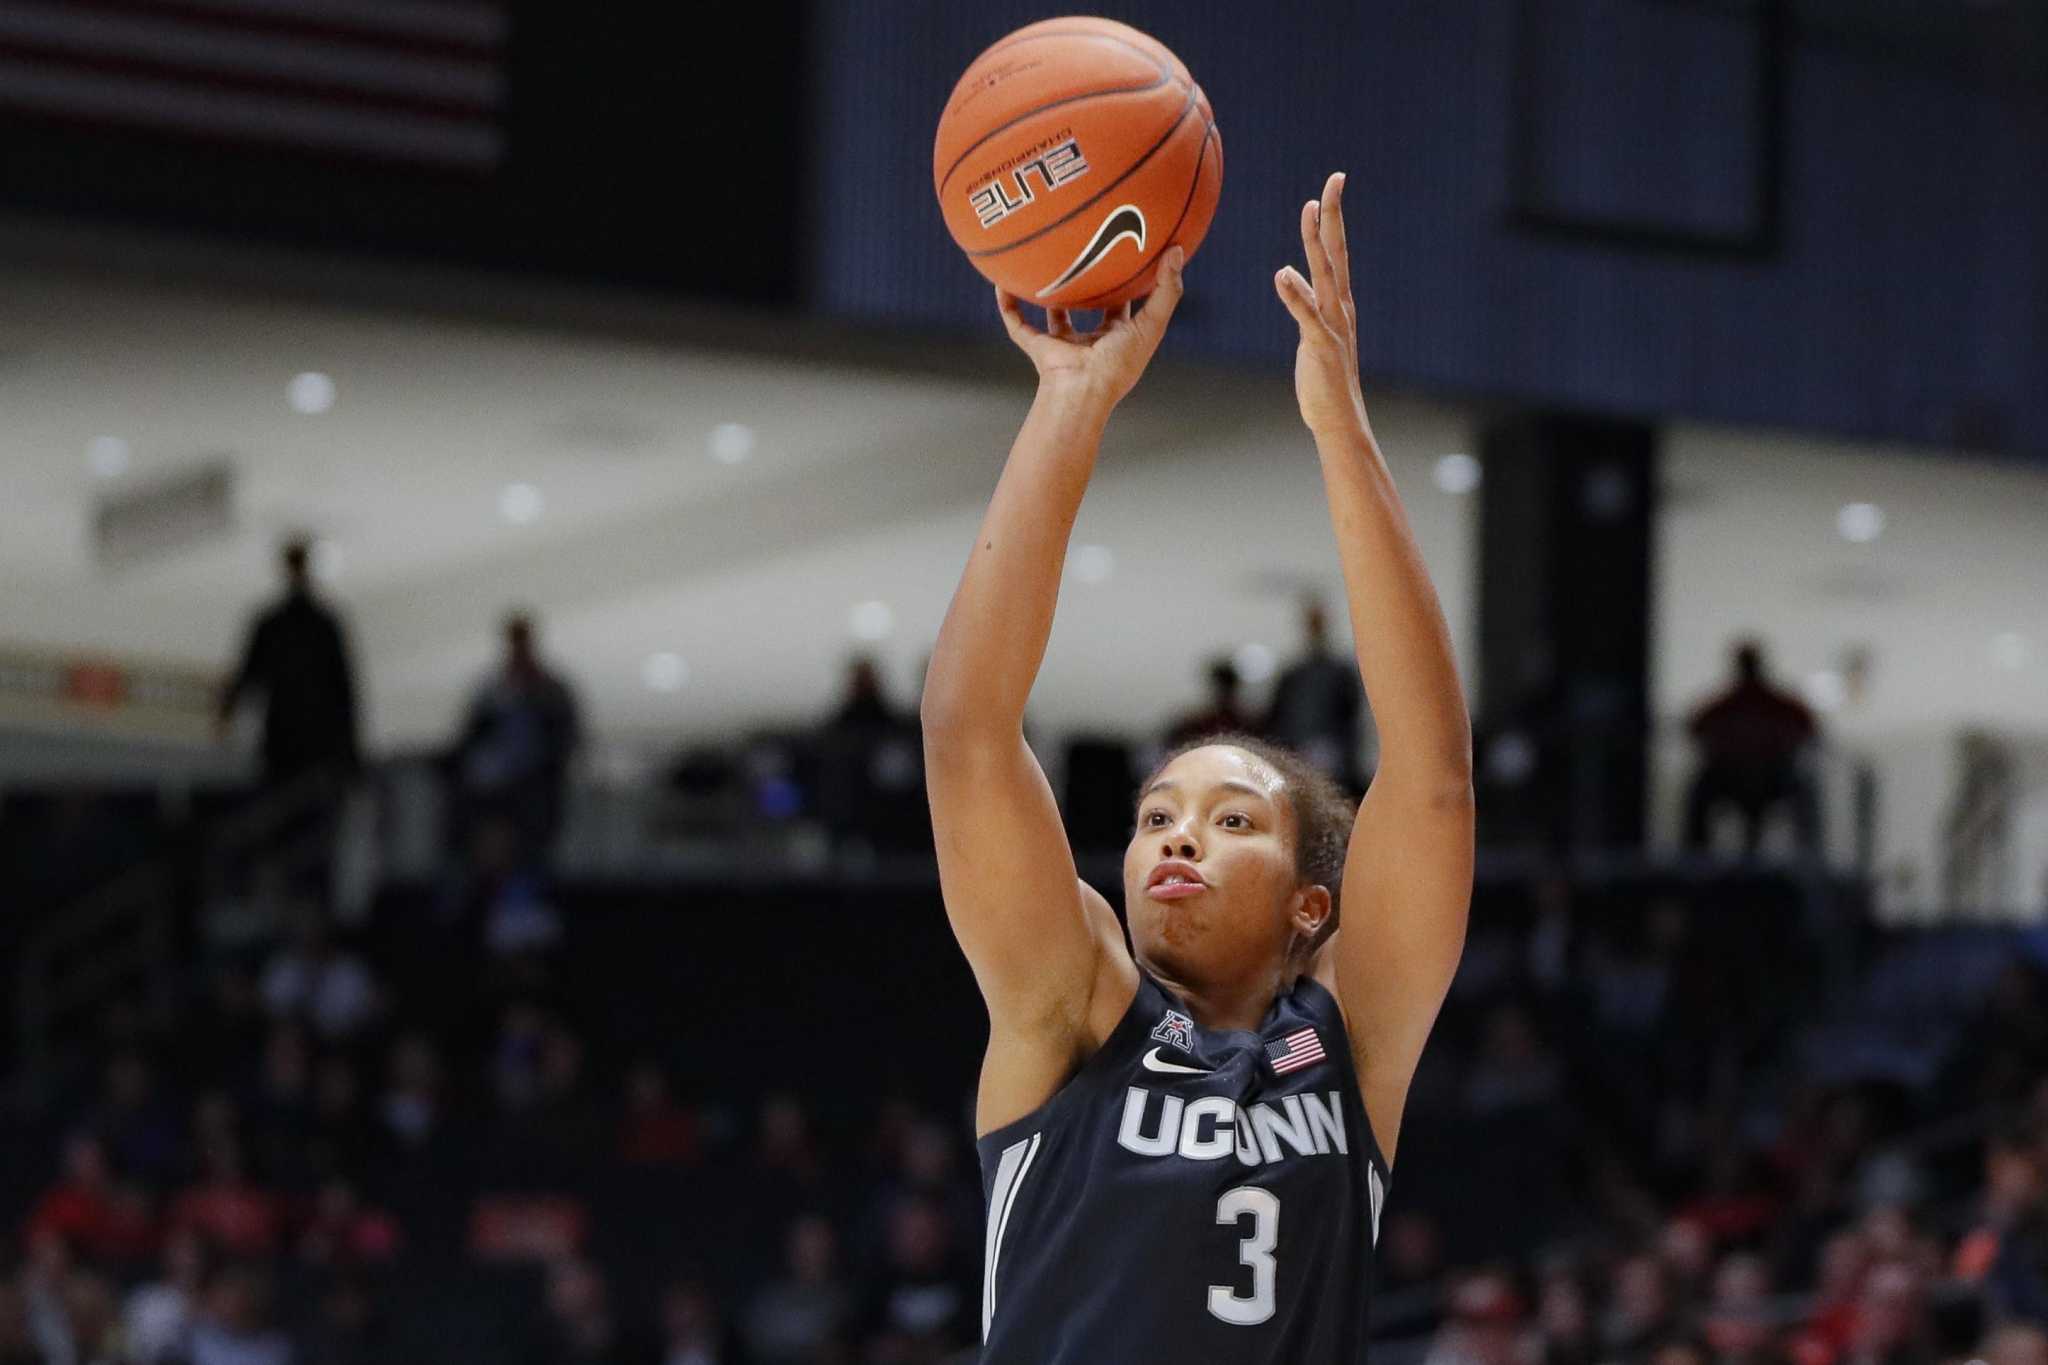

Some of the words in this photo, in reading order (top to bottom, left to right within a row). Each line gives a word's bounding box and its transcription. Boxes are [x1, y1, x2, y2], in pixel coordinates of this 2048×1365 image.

[969, 138, 1089, 229] ELITE
[1117, 1086, 1348, 1166] UCONN
[1207, 1186, 1280, 1326] 3
